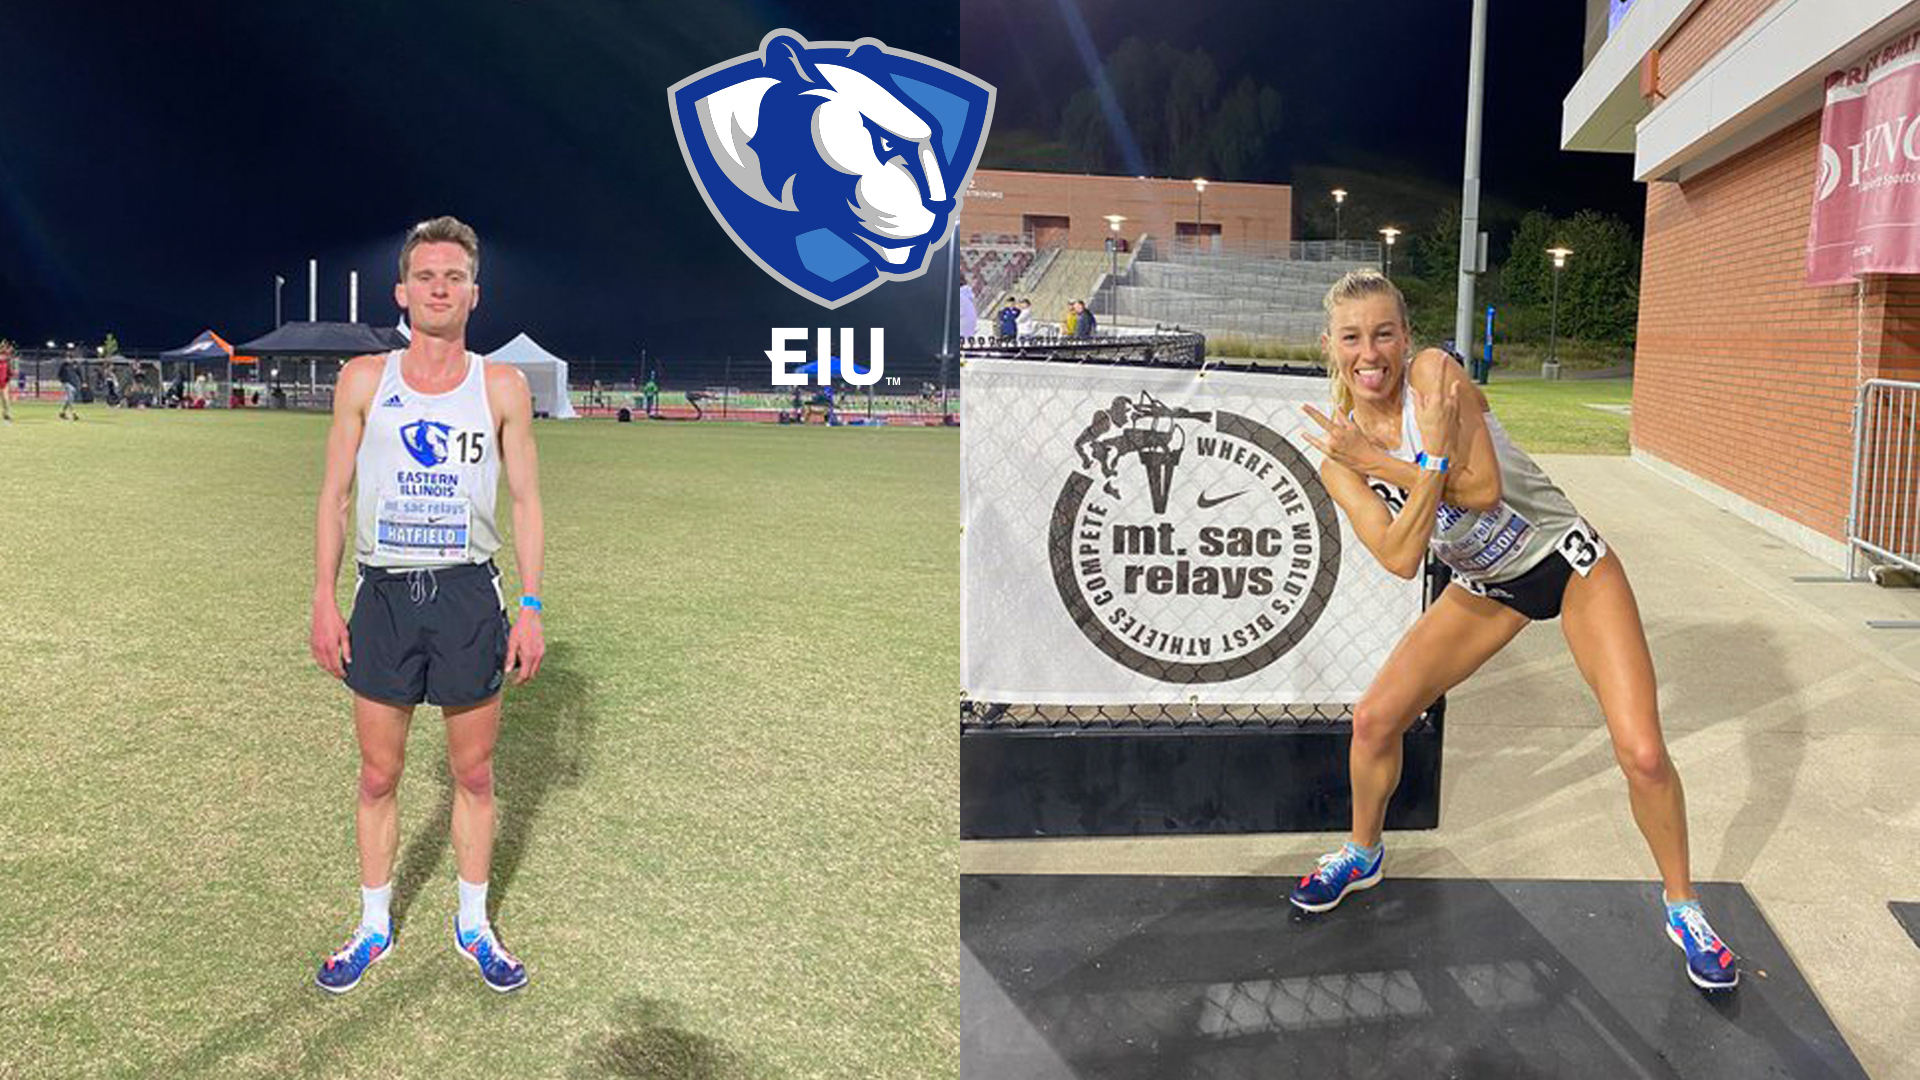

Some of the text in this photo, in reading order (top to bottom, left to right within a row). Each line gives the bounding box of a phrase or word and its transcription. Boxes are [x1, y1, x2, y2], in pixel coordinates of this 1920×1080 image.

[456, 431, 485, 464] 15
[397, 471, 459, 486] EASTERN
[400, 484, 455, 497] ILLINOIS
[388, 526, 456, 546] HATFIELD
[1079, 437, 1313, 656] WHERE THE WORLD'S BEST ATHLETES COMPETE
[1113, 522, 1283, 557] mt. sac
[1124, 560, 1274, 599] relays
